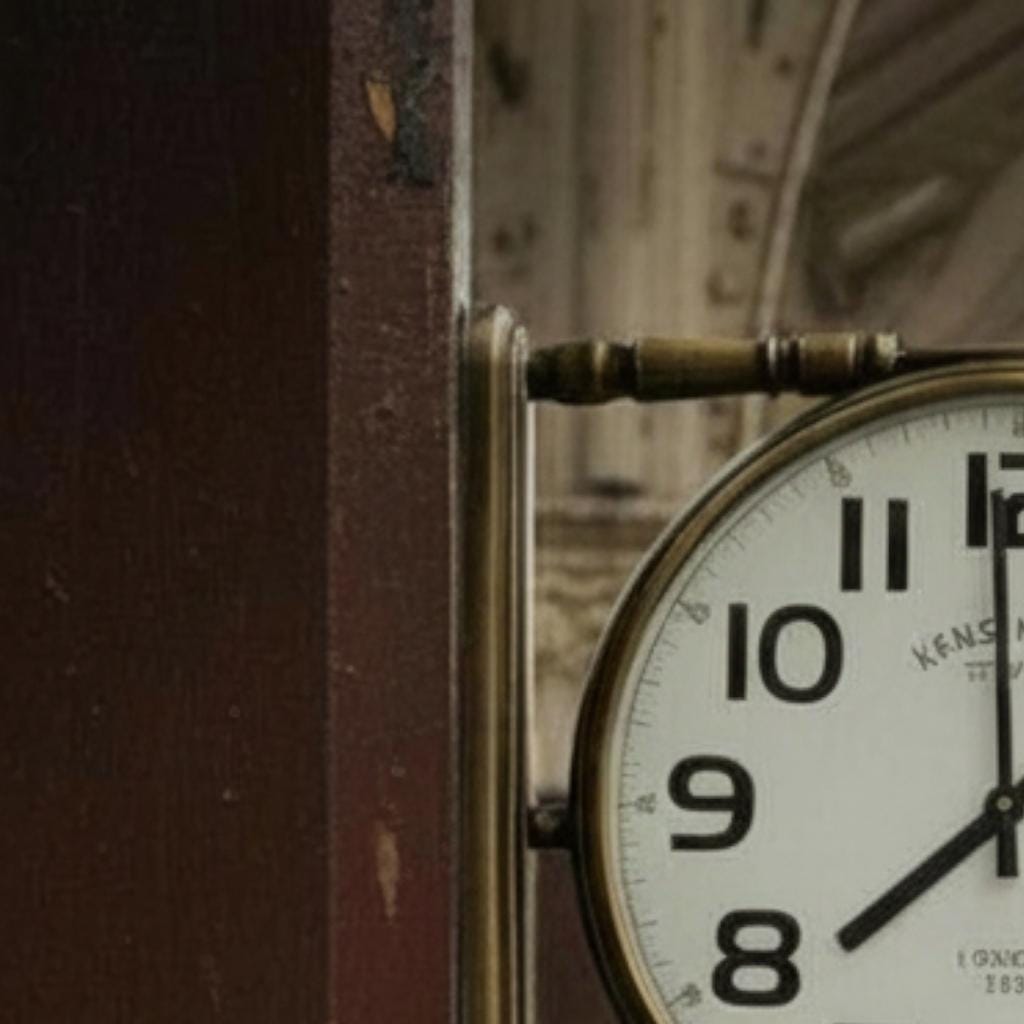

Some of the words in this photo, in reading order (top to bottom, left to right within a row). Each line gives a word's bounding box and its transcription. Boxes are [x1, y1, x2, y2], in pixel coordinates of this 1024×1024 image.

[840, 497, 908, 592] 11
[727, 603, 843, 703] 10
[668, 755, 755, 851] 9
[712, 910, 800, 1007] 8
